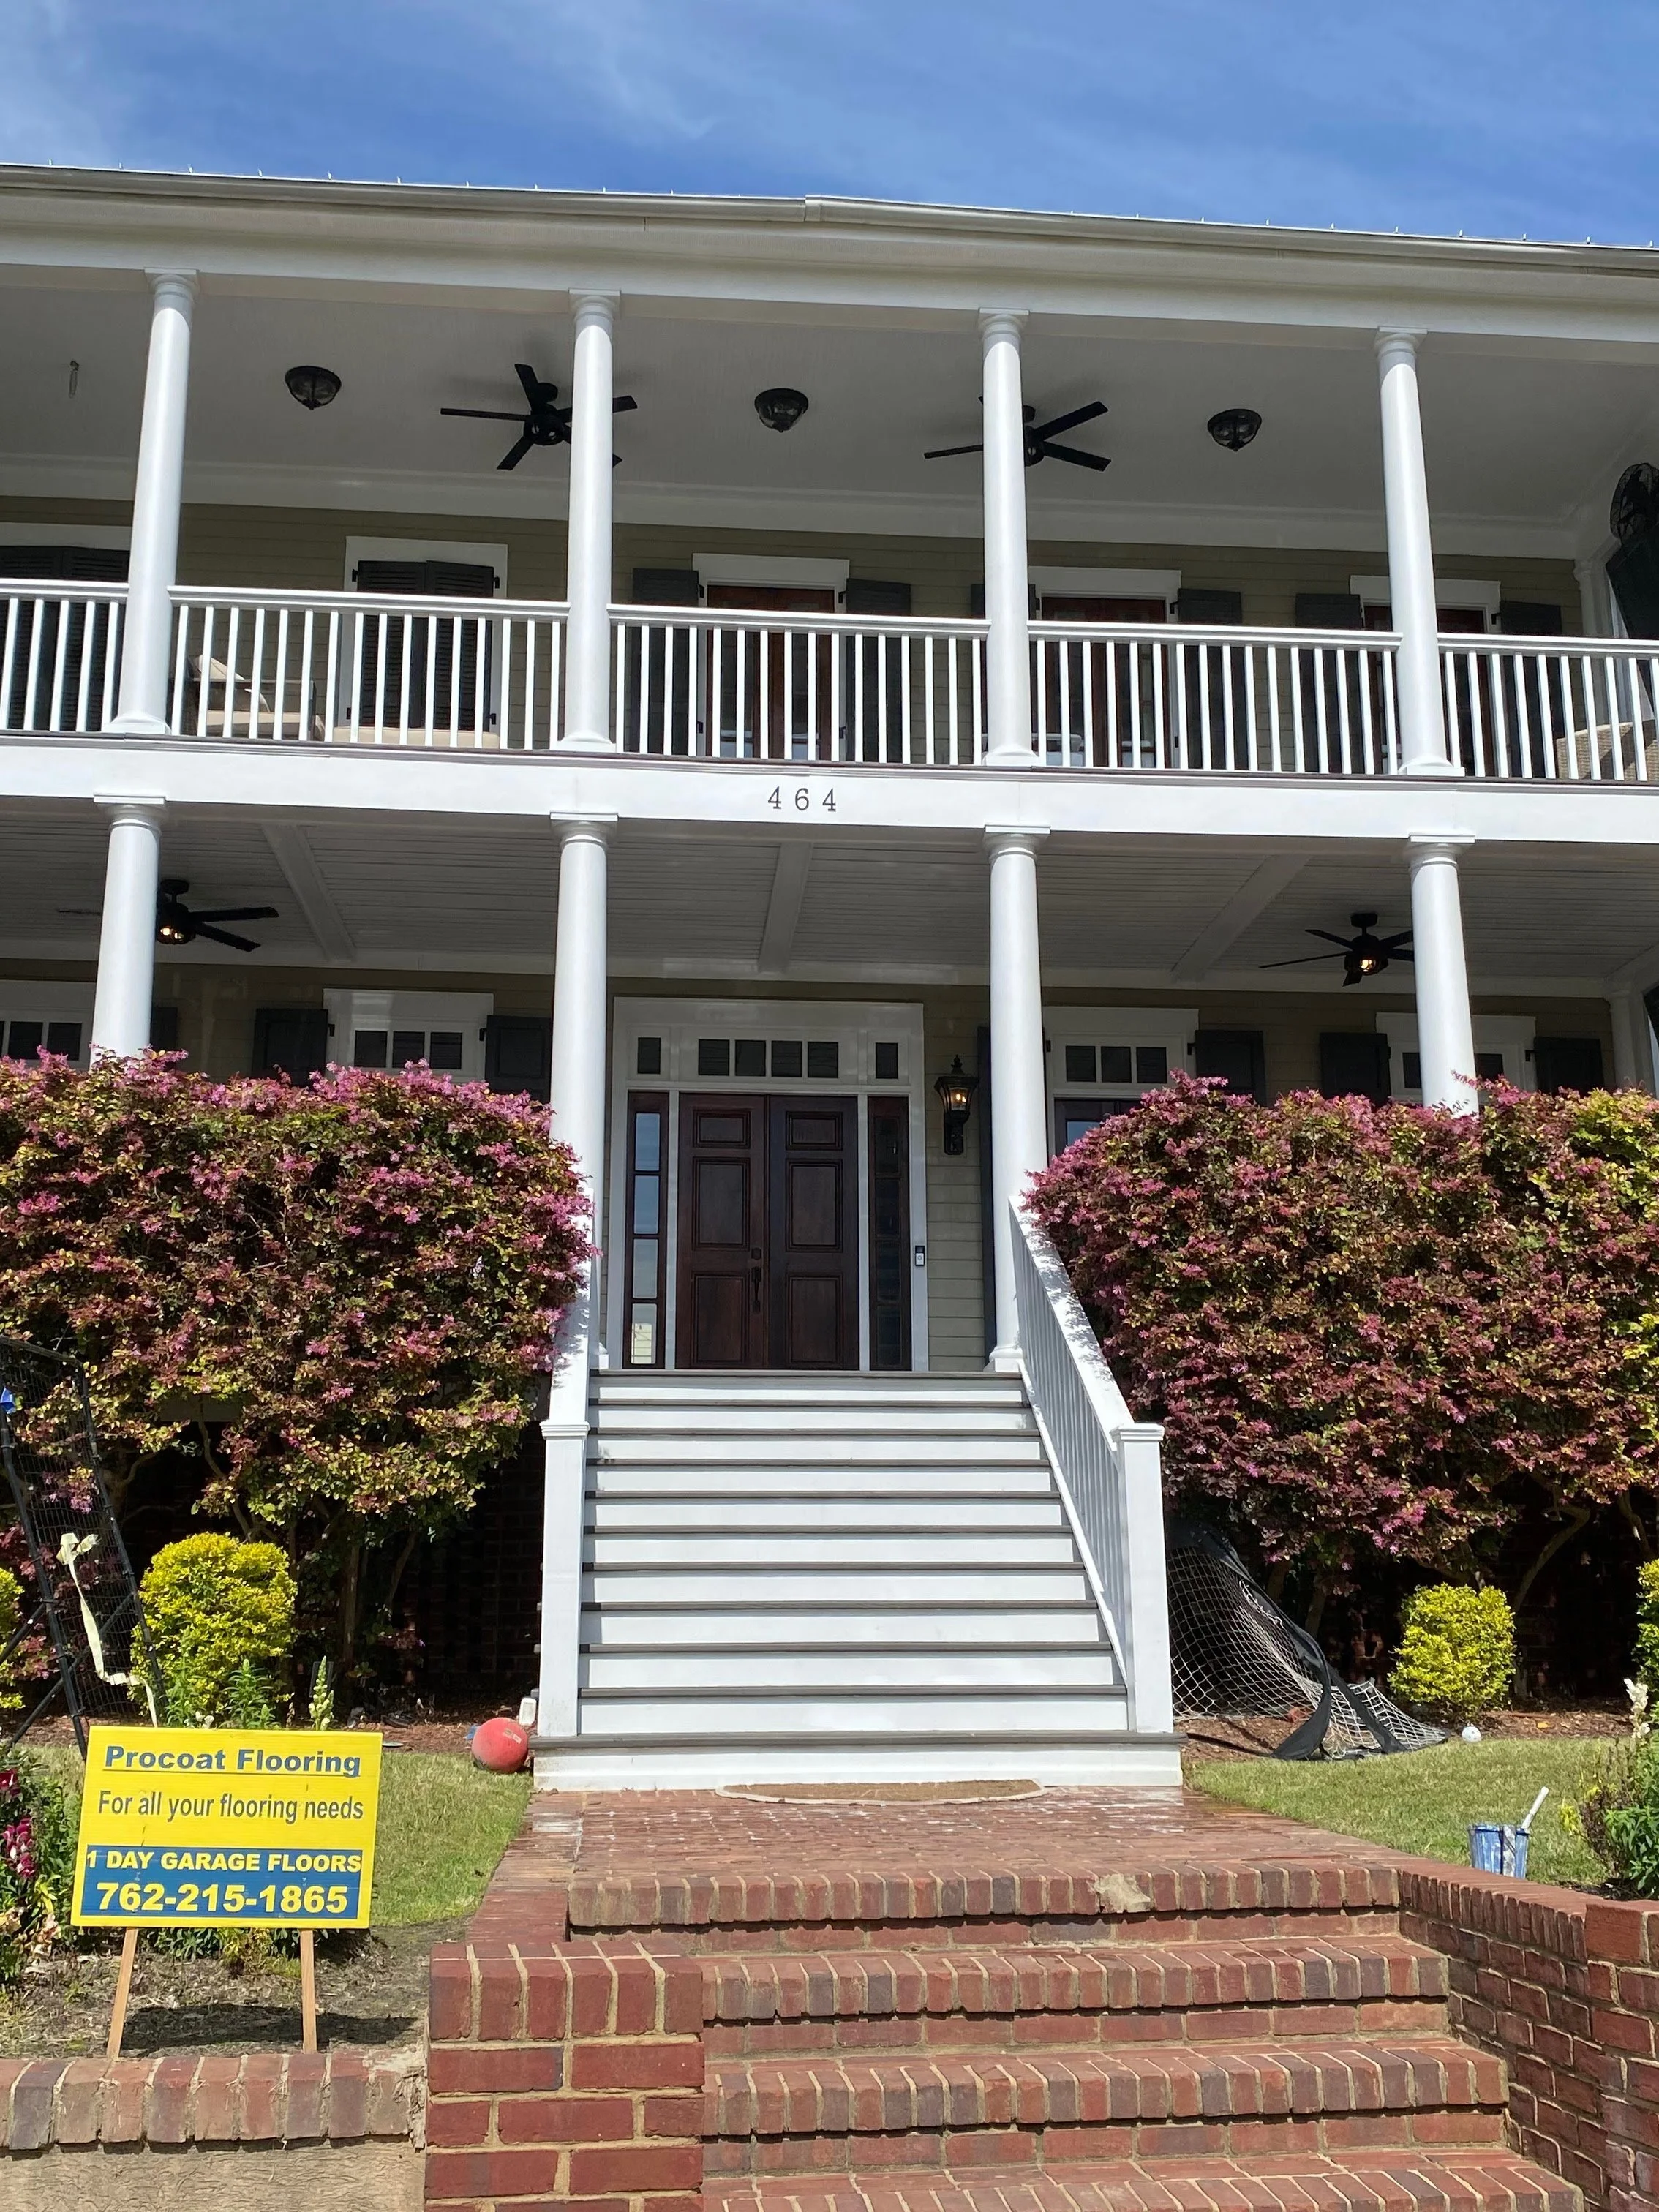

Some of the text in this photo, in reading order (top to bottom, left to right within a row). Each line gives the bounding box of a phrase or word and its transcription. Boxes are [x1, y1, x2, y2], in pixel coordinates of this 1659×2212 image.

[767, 786, 836, 812] 464
[105, 1746, 361, 1777] Procoat Flooring
[98, 1790, 364, 1824] For all your flooring needs
[86, 1851, 361, 1873] 1 DAY GARAGE FLOORS
[97, 1882, 347, 1914] 762-215-1865
